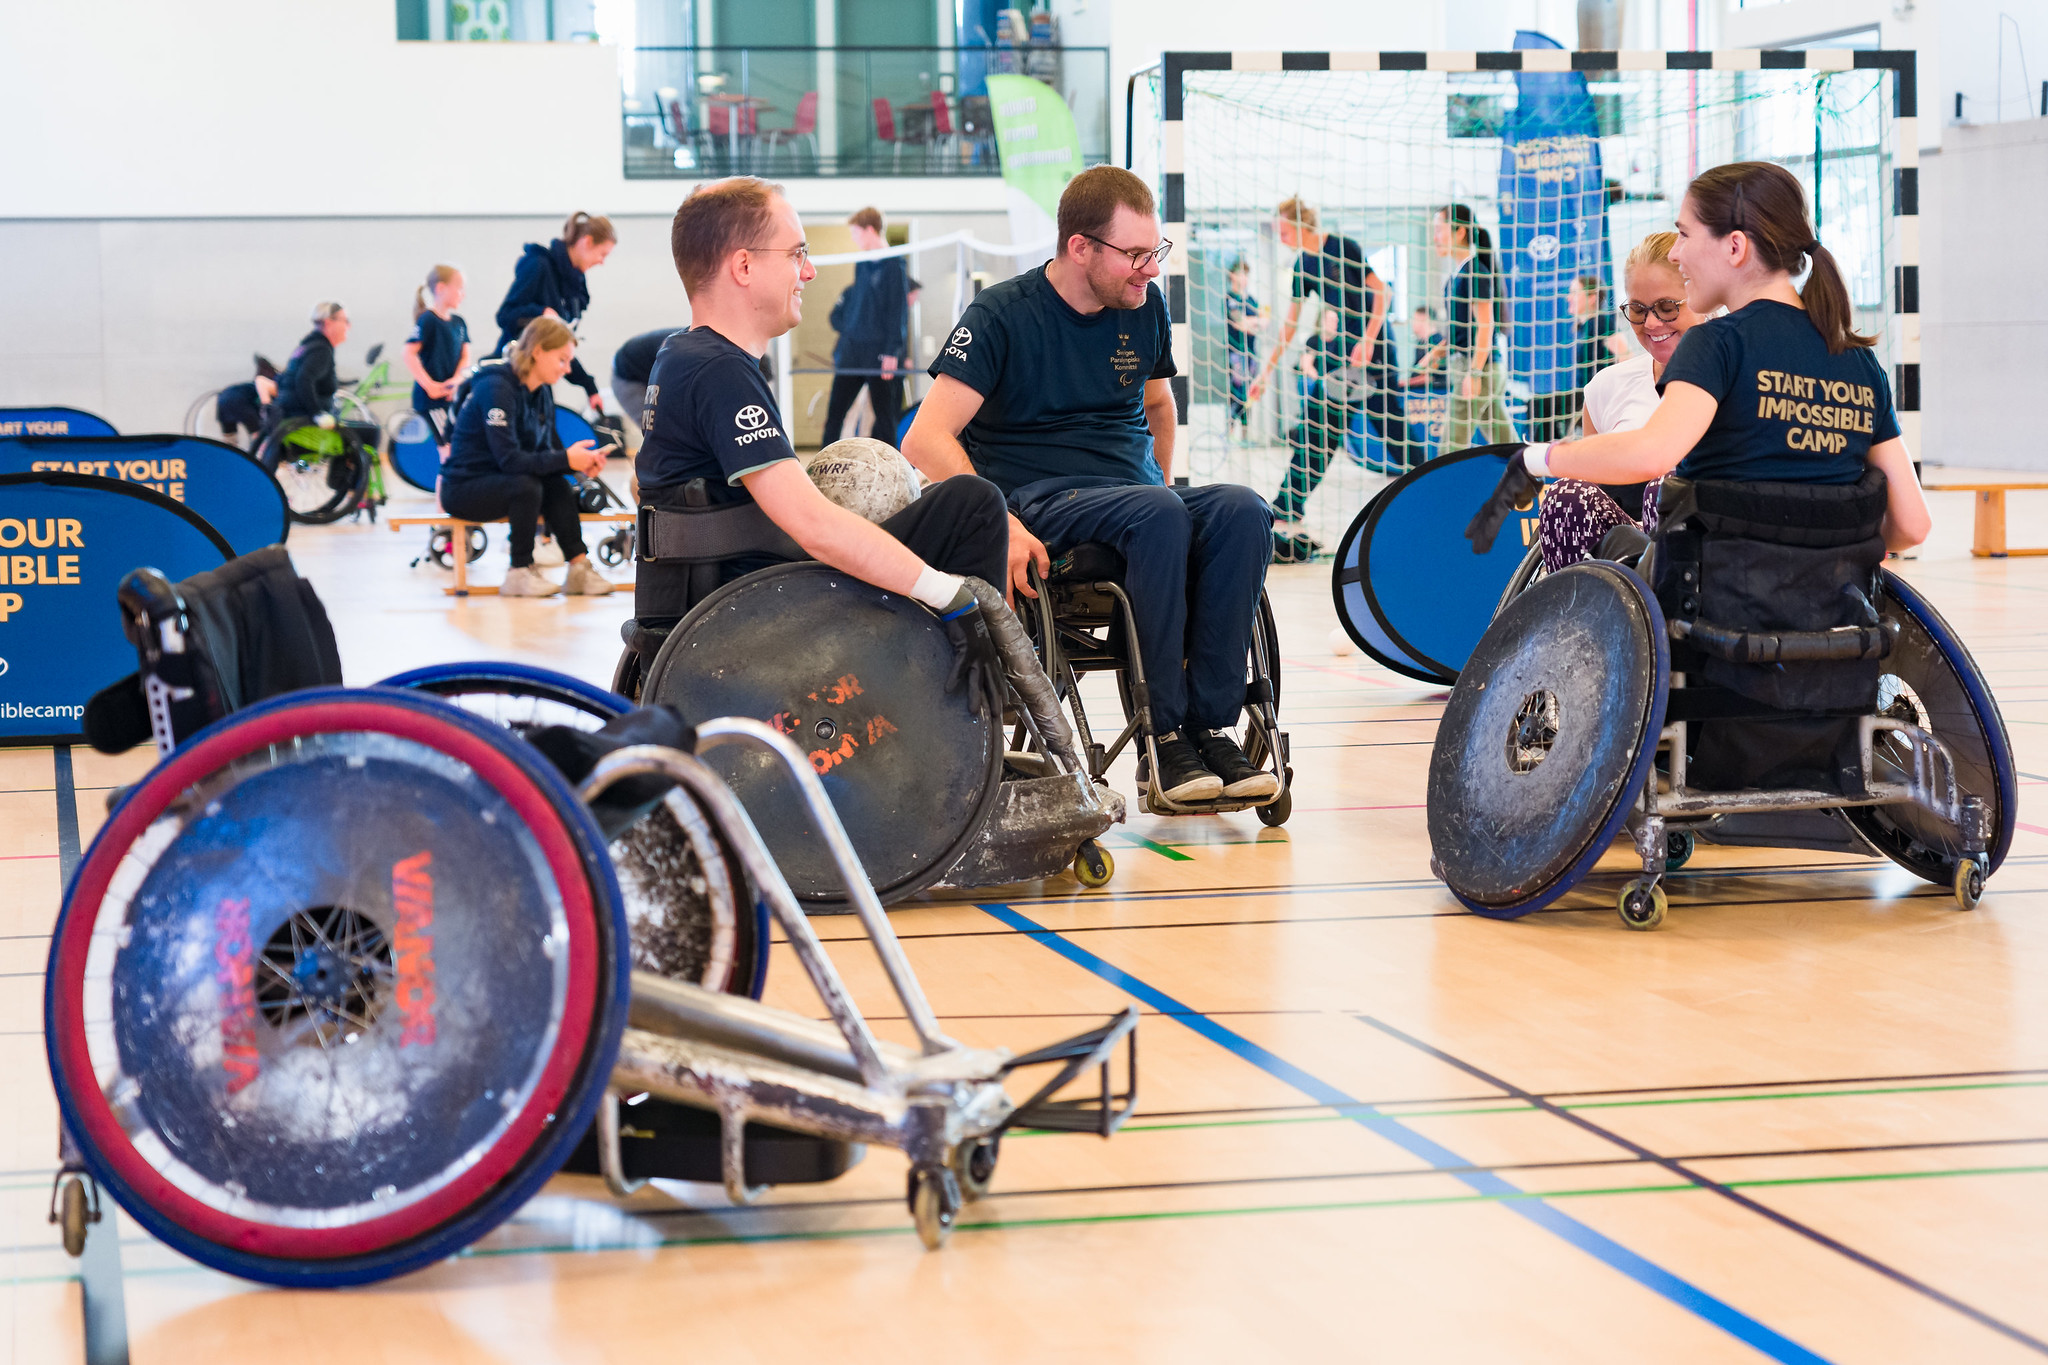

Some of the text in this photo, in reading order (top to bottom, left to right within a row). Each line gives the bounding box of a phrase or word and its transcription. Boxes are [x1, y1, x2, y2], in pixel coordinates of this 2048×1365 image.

[1757, 369, 1876, 409] START YOUR
[1757, 396, 1874, 434] IMPOSSIBLE
[25, 421, 69, 435] YOUR
[734, 427, 780, 447] TOYOTA
[1786, 427, 1848, 454] CAMP
[114, 458, 187, 481] YOUR
[0, 702, 85, 720] iblecamp
